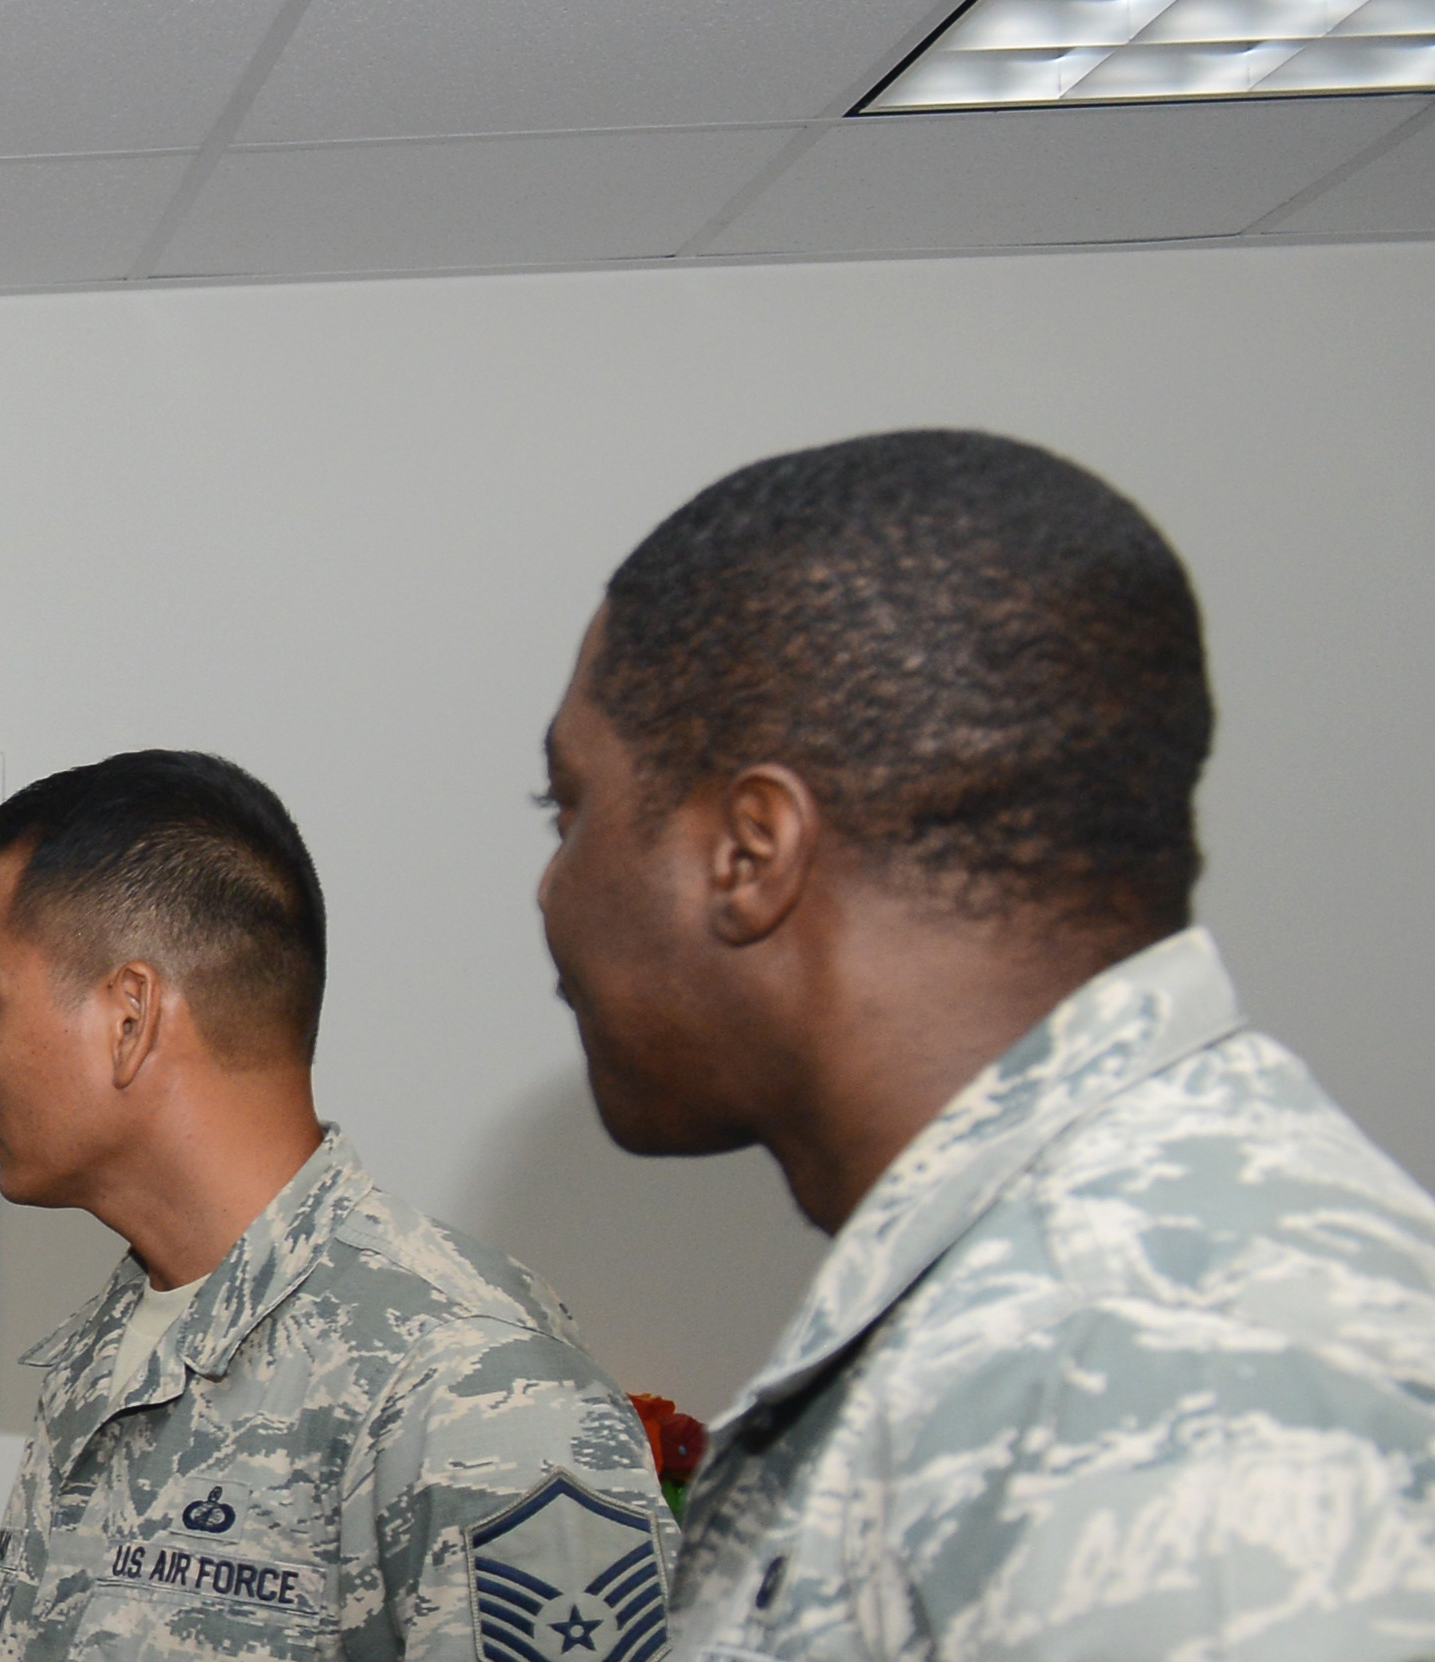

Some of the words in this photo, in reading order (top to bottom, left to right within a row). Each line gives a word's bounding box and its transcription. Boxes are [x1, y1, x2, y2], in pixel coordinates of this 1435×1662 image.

[112, 1545, 145, 1578] U.S.
[149, 1549, 191, 1586] AIR
[195, 1556, 300, 1605] FORCE
